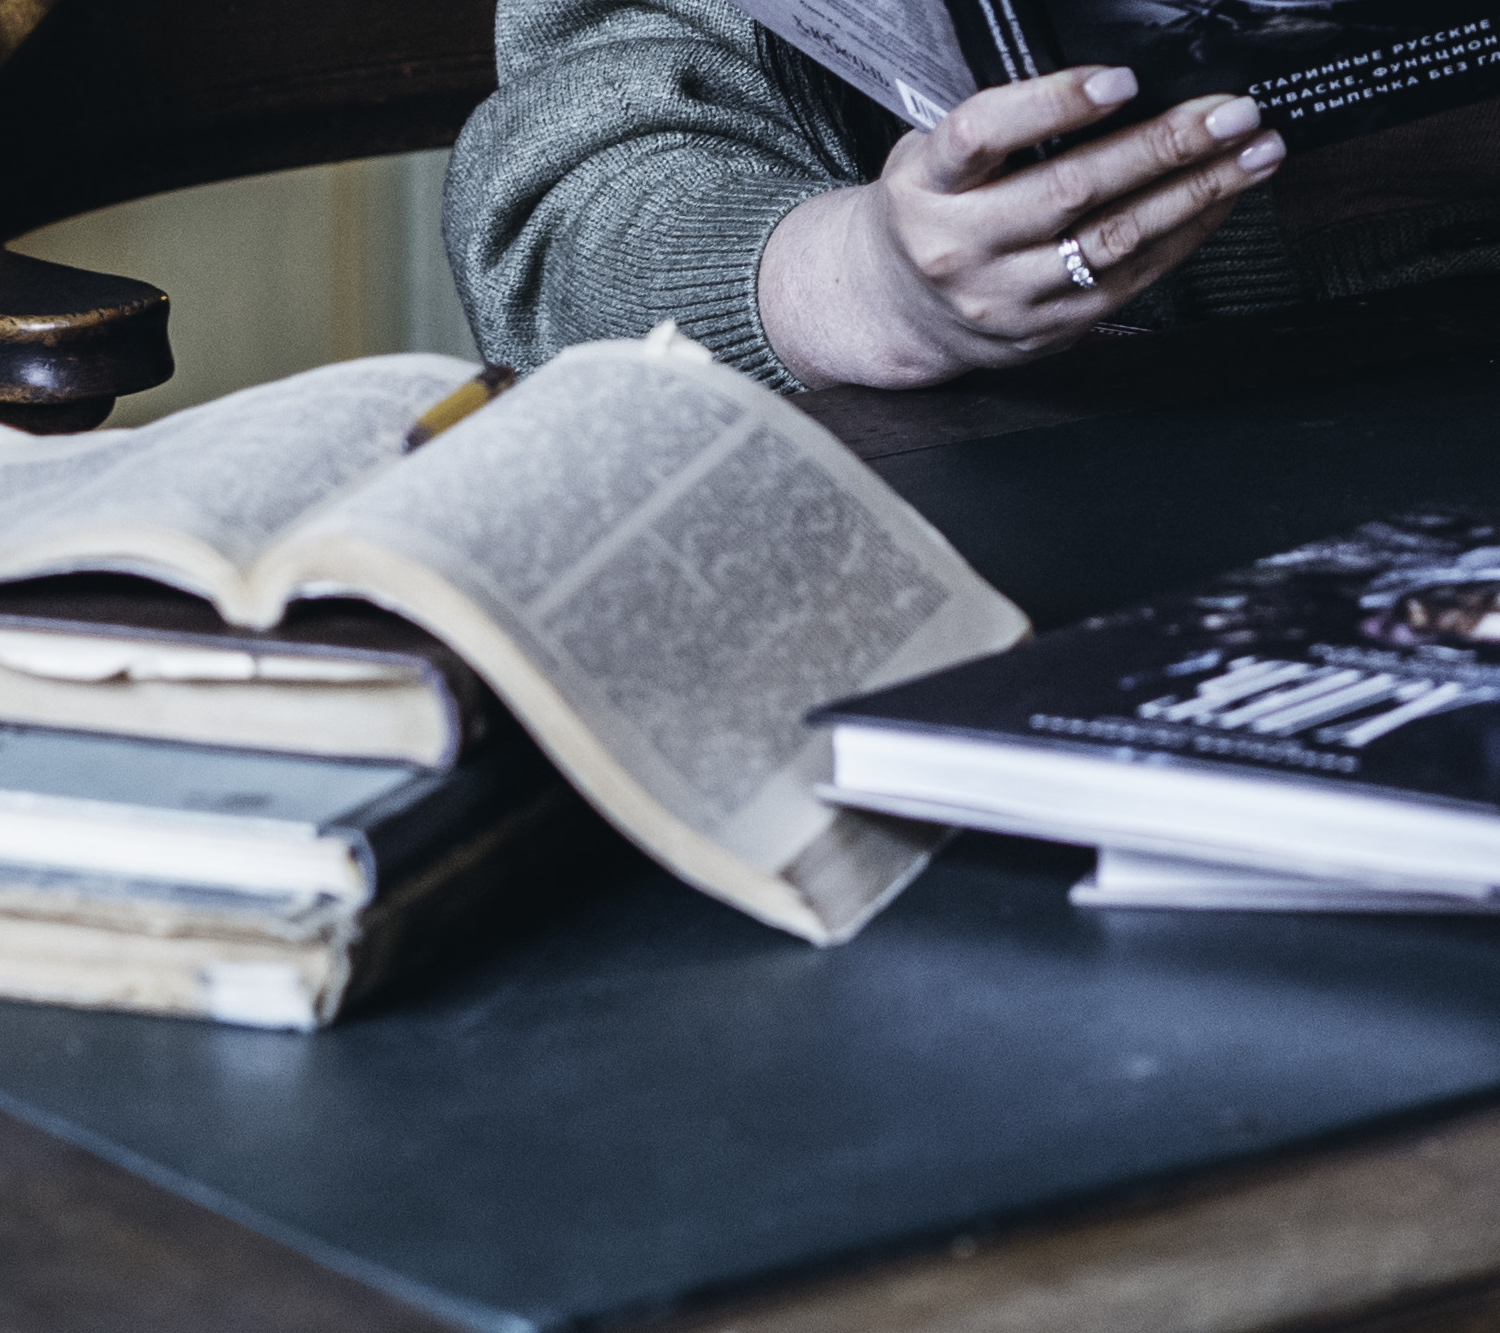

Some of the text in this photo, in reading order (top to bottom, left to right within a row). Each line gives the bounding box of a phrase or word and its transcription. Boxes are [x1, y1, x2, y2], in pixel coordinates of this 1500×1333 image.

[1247, 47, 1384, 96] СТАРИННЫЕ
[1392, 17, 1492, 55] РУССКИЕ
[1258, 72, 1365, 111] АКВАСКЕ,
[1289, 106, 1305, 121] И
[1312, 74, 1421, 114] ВЫПЕЧКА
[1428, 59, 1469, 81] БЕЗ
